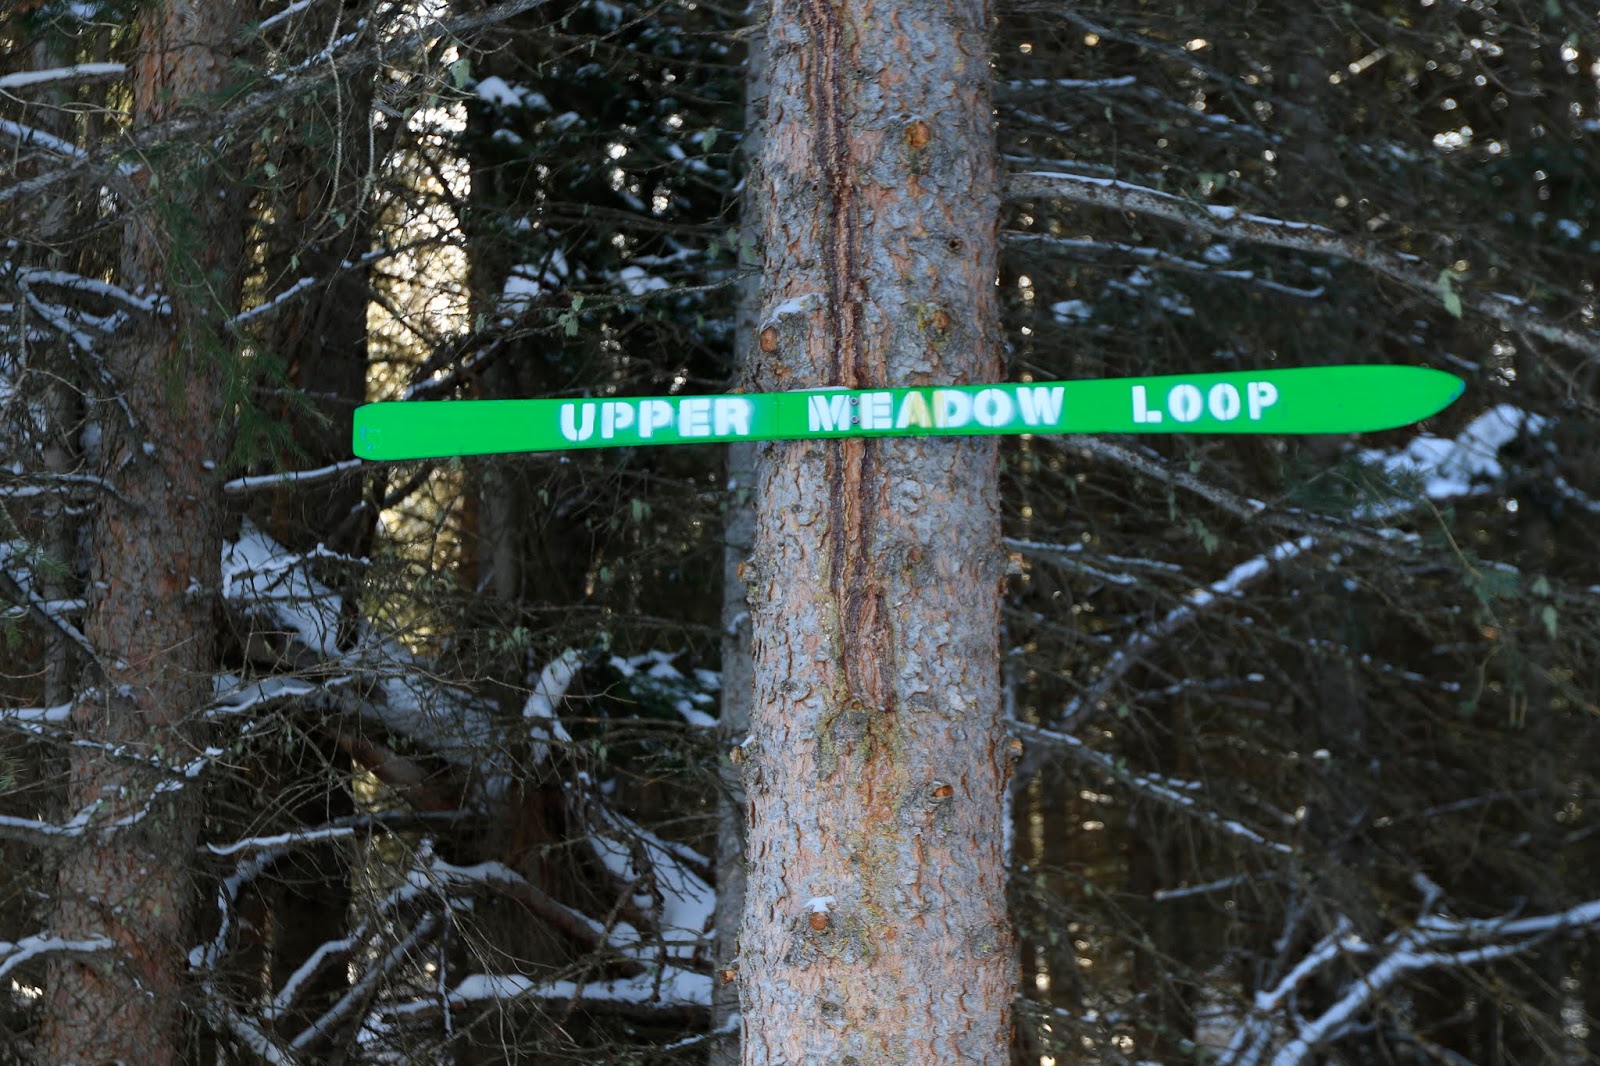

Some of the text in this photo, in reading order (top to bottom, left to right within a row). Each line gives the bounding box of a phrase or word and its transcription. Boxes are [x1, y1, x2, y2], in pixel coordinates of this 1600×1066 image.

[560, 381, 1278, 441] UPPER MEADOW LOOP
